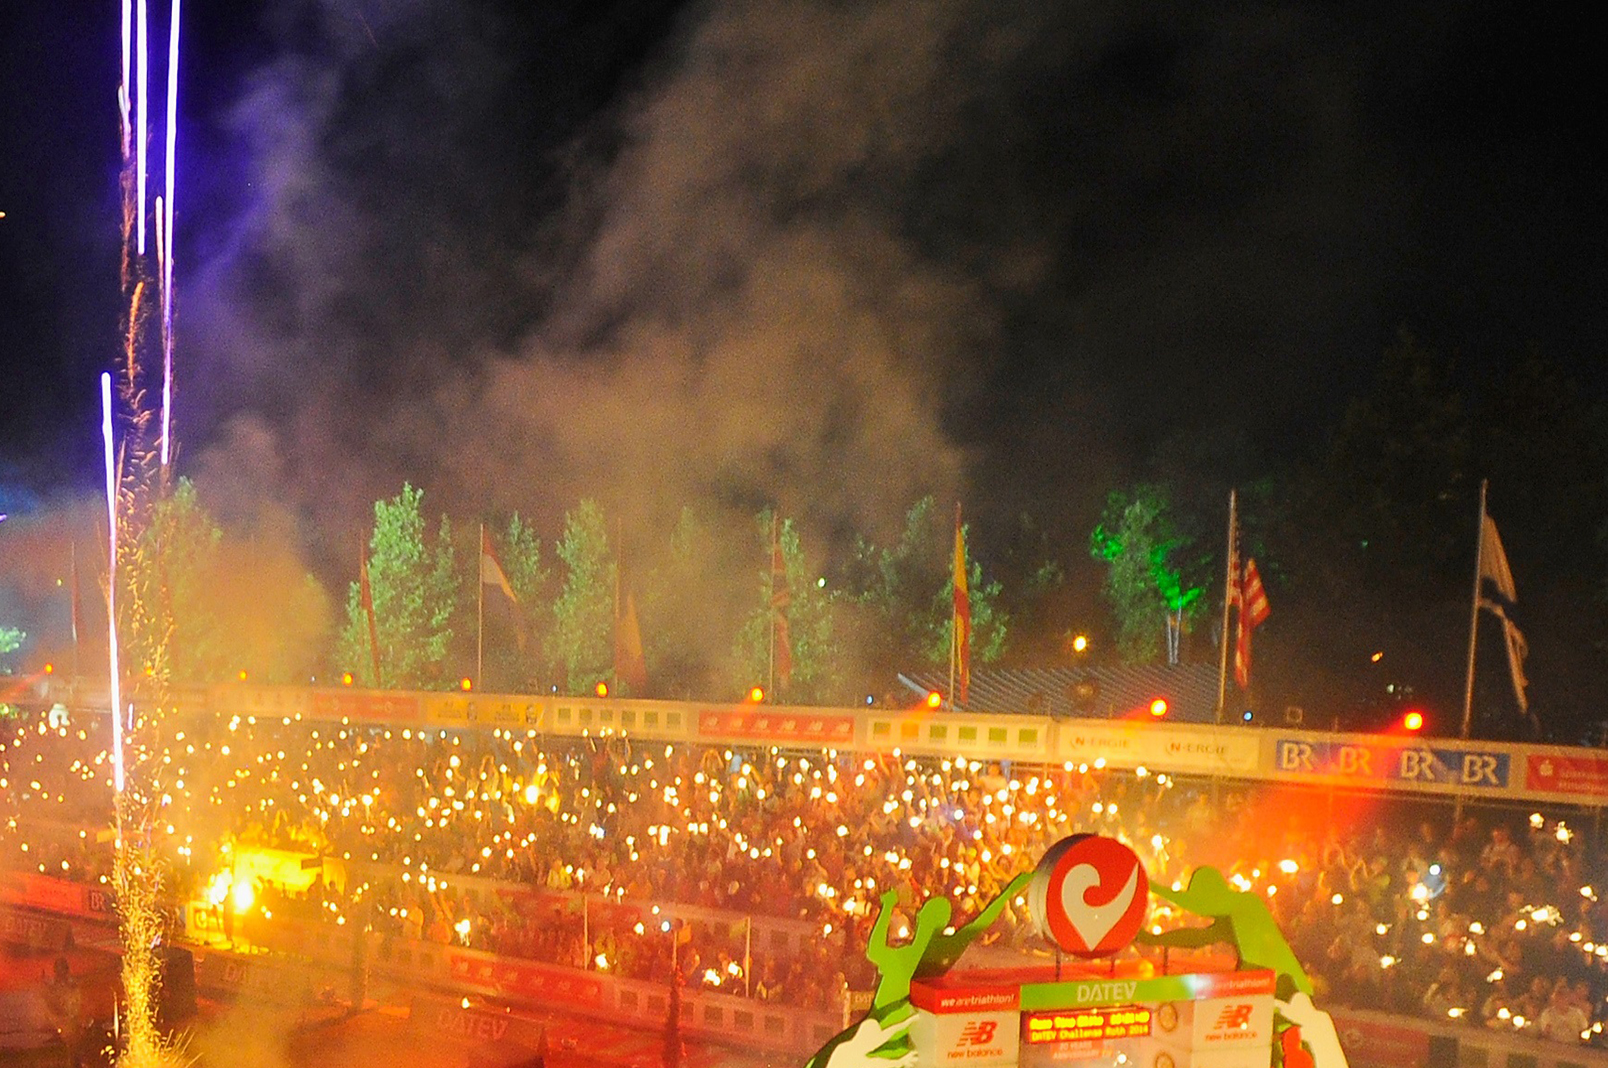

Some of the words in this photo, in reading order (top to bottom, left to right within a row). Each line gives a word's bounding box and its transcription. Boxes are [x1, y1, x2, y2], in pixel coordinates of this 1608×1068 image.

[1282, 742, 1315, 771] BR
[1340, 746, 1374, 775] BR
[1401, 749, 1435, 780] BR
[1463, 753, 1500, 785] BR
[1077, 981, 1138, 1002] DATEV
[967, 1048, 1003, 1058] balance
